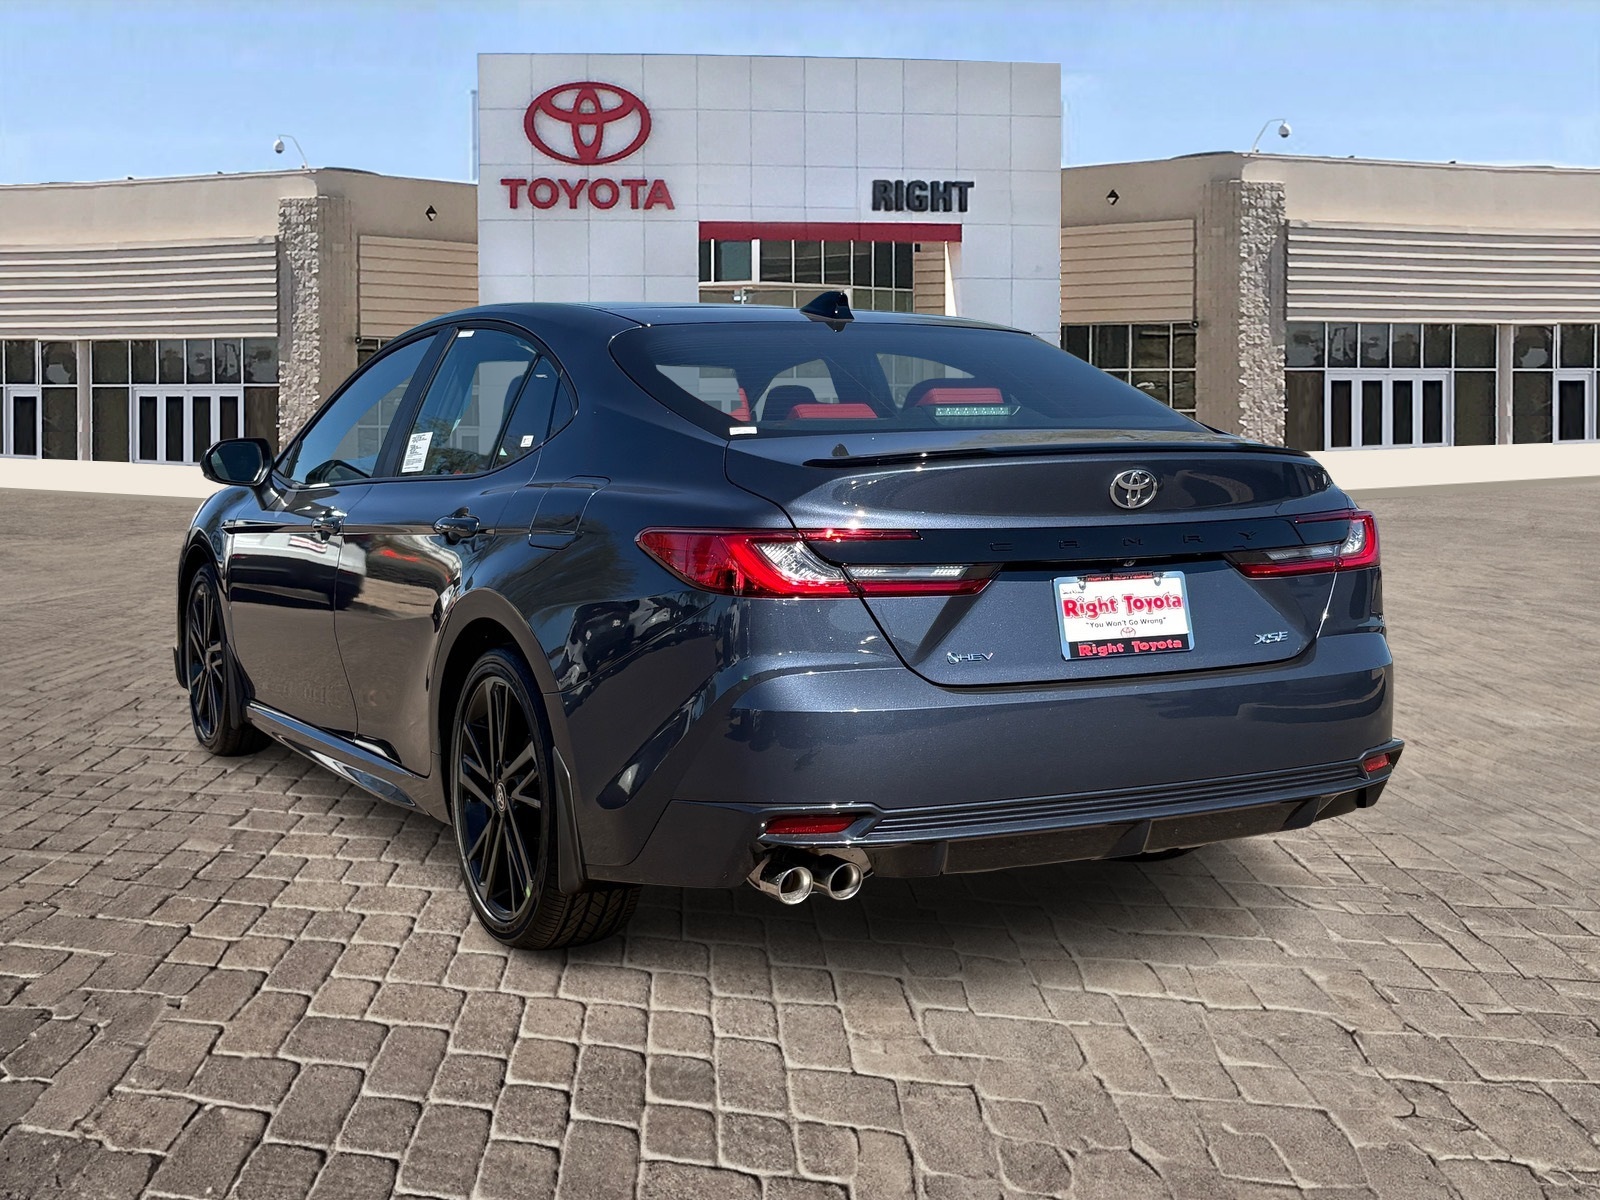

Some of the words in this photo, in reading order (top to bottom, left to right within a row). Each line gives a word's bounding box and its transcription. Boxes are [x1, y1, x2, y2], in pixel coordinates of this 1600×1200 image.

[500, 178, 675, 209] TOYOTA
[872, 180, 975, 212] RIGHT
[989, 531, 1257, 551] CAMRY
[1062, 597, 1118, 619] Right
[1124, 593, 1182, 615] Toyota
[1078, 643, 1124, 656] Right
[1131, 639, 1182, 652] Toyota
[1254, 631, 1288, 644] XSE
[957, 652, 993, 662] HEV
